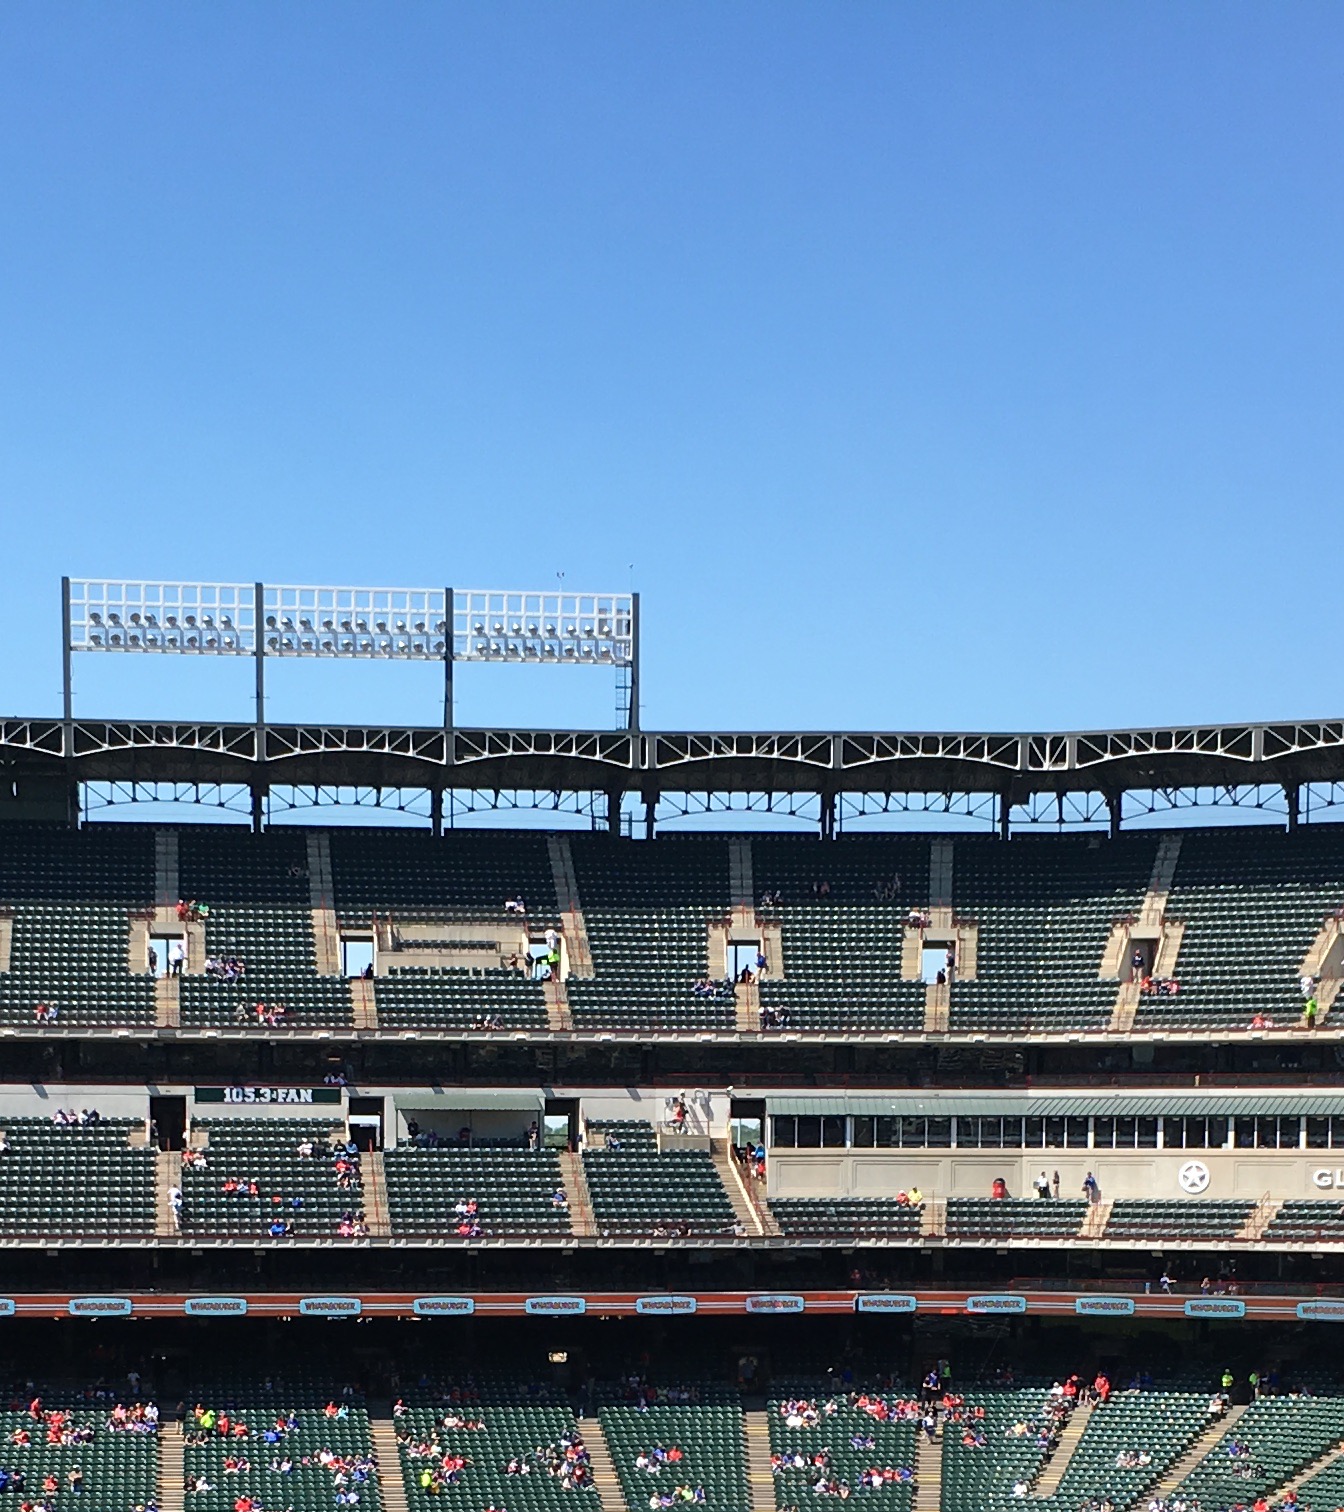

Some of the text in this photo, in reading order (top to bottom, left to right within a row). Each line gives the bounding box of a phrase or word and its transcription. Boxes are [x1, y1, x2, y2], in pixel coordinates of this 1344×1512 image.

[223, 1087, 271, 1103] 105.3
[277, 1088, 313, 1103] FAN
[75, 1302, 127, 1312] WHATABURGER
[191, 1302, 242, 1312] WHATABURGER
[304, 1302, 356, 1312] WHATABURGER
[418, 1301, 468, 1311] WHATABURGER
[530, 1301, 580, 1311] WHATABURGER
[642, 1301, 690, 1311] WHATABURGER
[751, 1300, 799, 1309] WHATABURGER
[862, 1299, 911, 1308] WHATABURGER
[971, 1299, 1021, 1309] WHATABURGER
[1080, 1301, 1129, 1311] WHATABURGER
